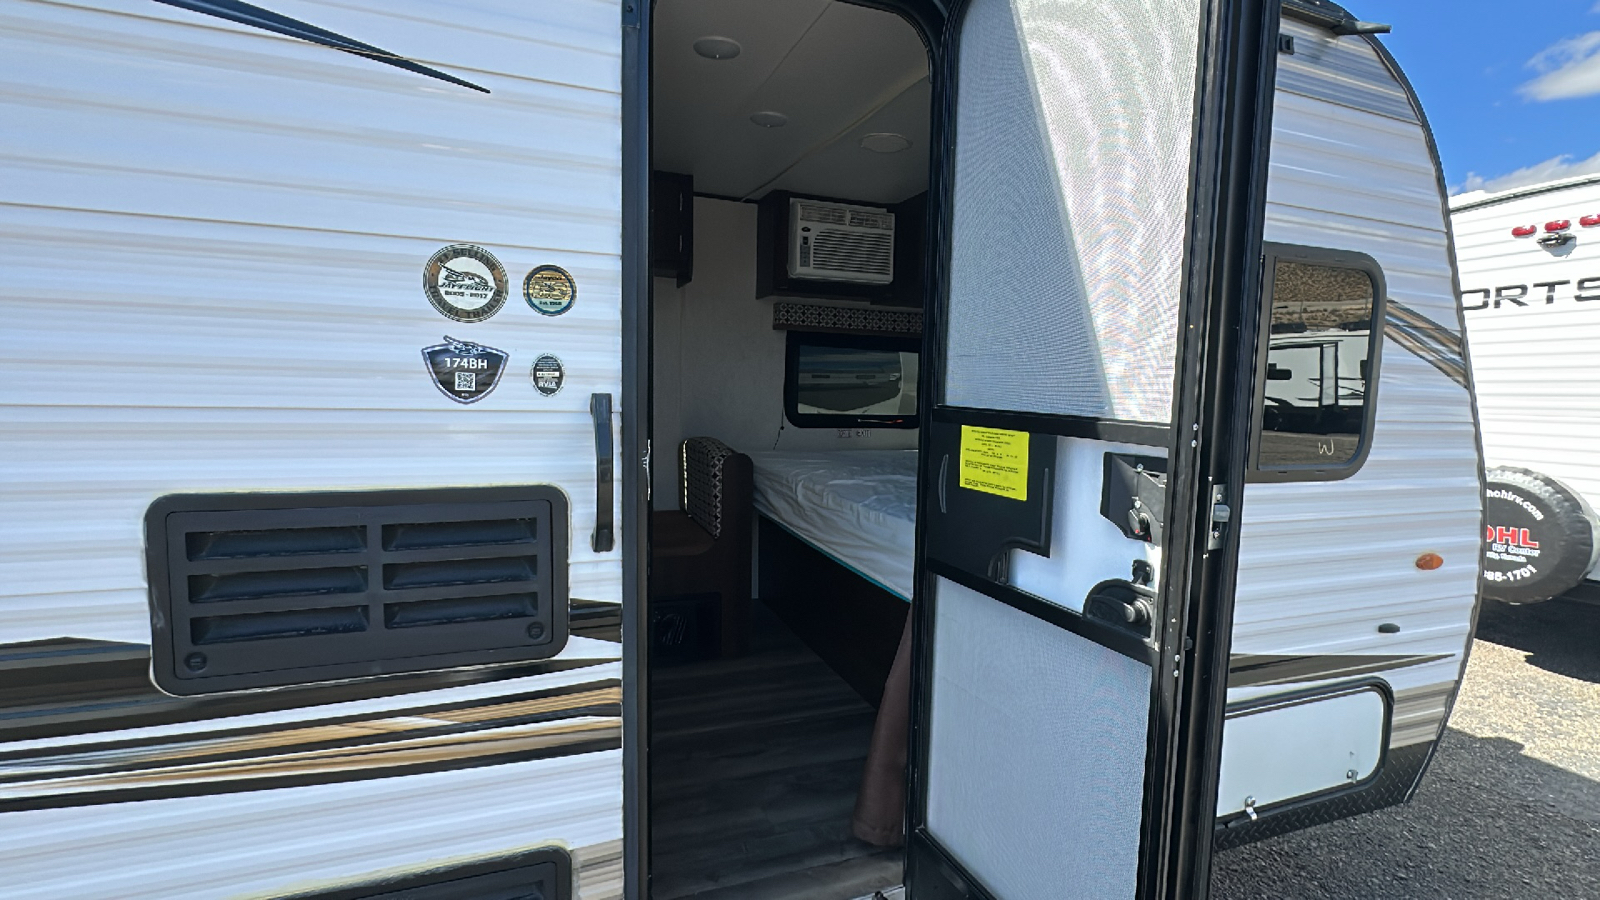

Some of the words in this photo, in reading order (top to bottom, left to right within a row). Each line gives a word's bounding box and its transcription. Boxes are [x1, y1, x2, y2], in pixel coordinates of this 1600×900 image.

[452, 248, 497, 271] SELLING
[429, 286, 460, 317] TRAVEL
[466, 289, 503, 318] TRAILER
[444, 357, 488, 369] 174BH
[1508, 545, 1540, 557] Center
